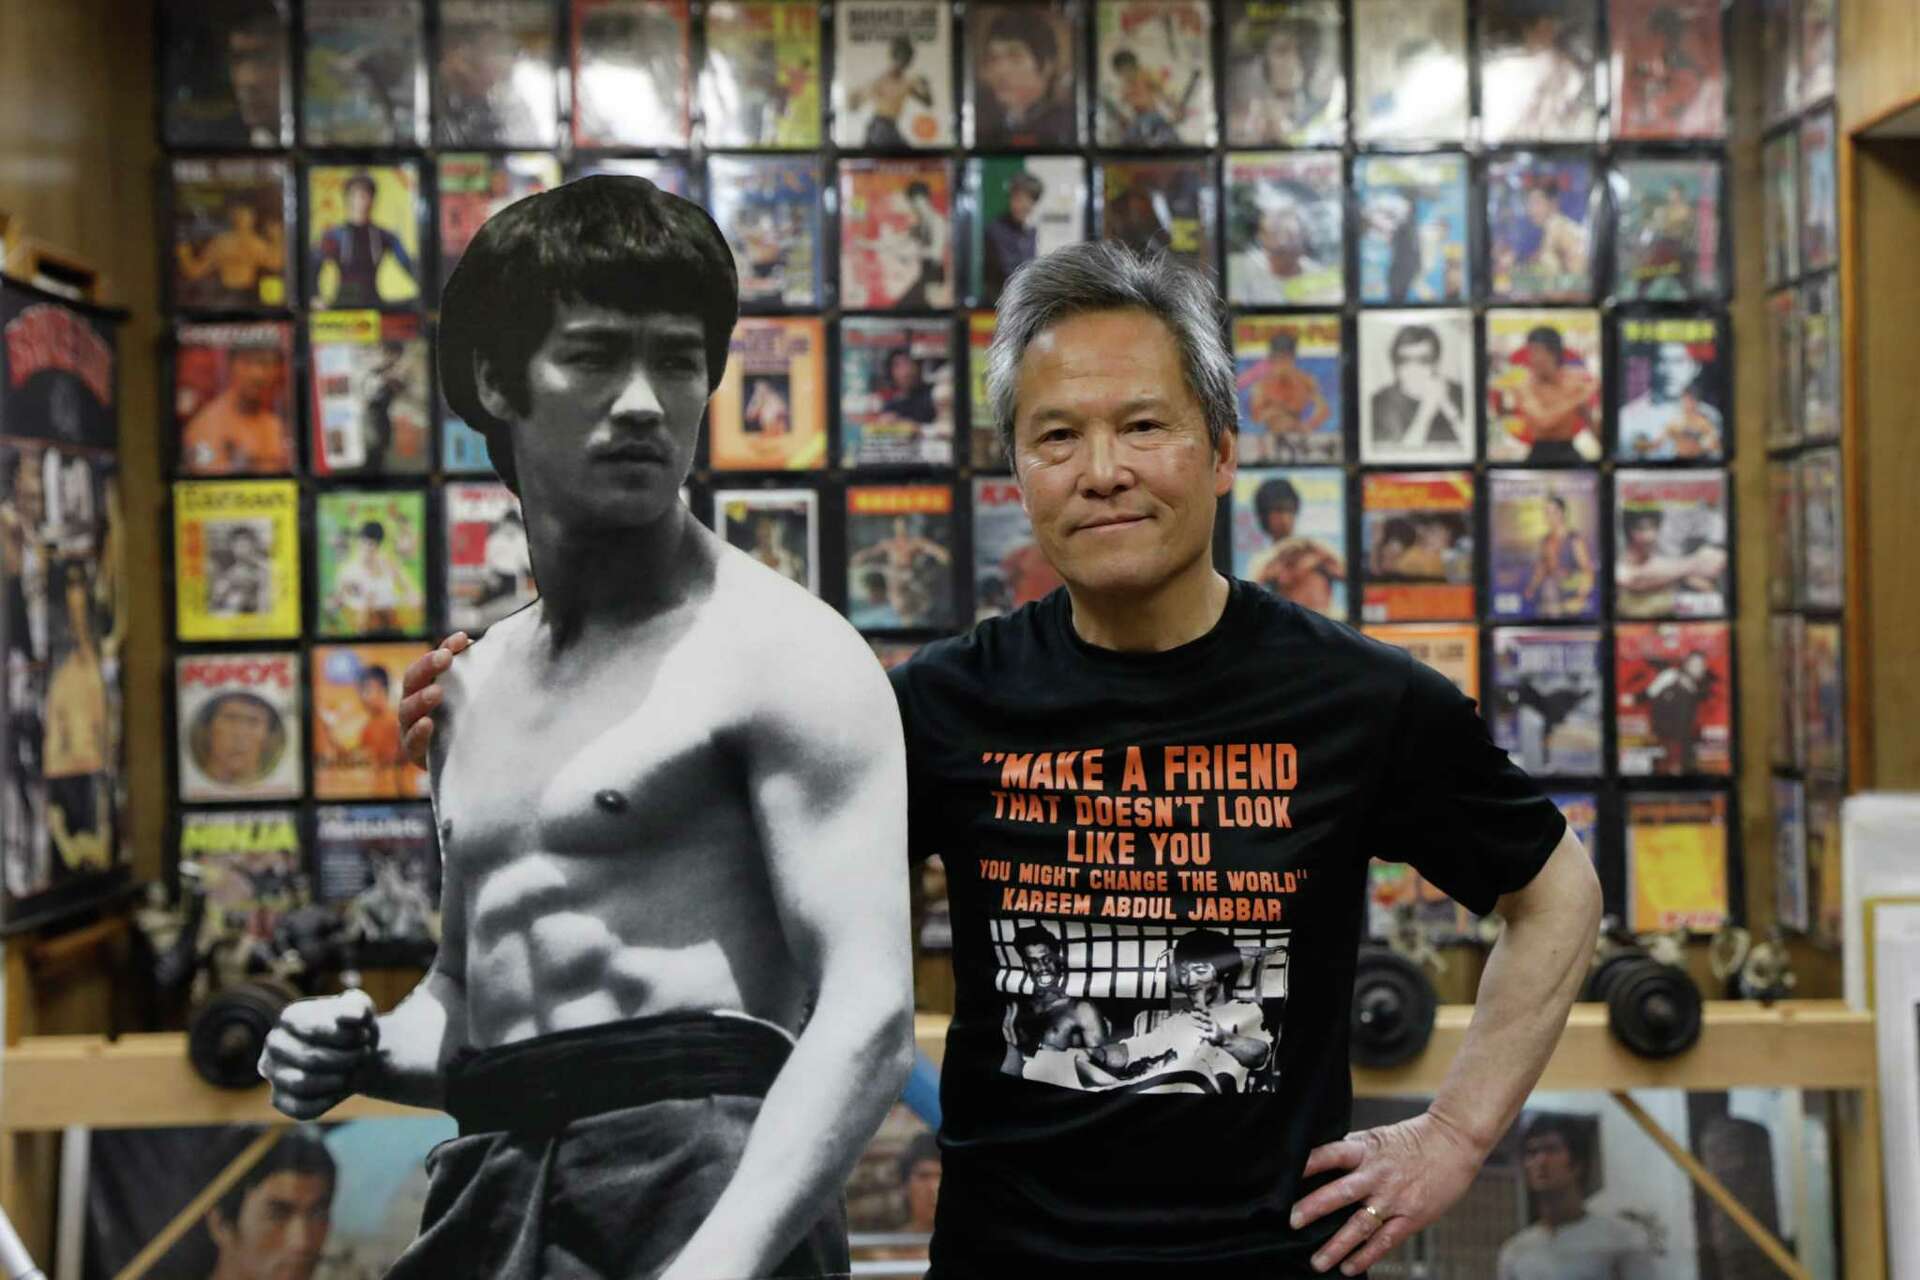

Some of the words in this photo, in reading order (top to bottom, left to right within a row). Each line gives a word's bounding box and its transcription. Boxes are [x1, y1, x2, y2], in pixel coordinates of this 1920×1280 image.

[1121, 746, 1147, 791] A
[1164, 743, 1298, 790] FRIEND
[991, 791, 1060, 823] THAT
[1075, 796, 1204, 827] DOESN'T
[1217, 796, 1292, 828] LOOK
[1067, 830, 1135, 865] LIKE
[1149, 832, 1211, 866] YOU
[980, 859, 1011, 881] YOU
[1019, 863, 1080, 888] MIGHT
[1090, 869, 1168, 892] CHANGE
[1178, 870, 1218, 892] THE
[1001, 888, 1091, 915] KAREEM
[1101, 896, 1177, 919] ABDUL
[1188, 897, 1282, 921] JABBAR
